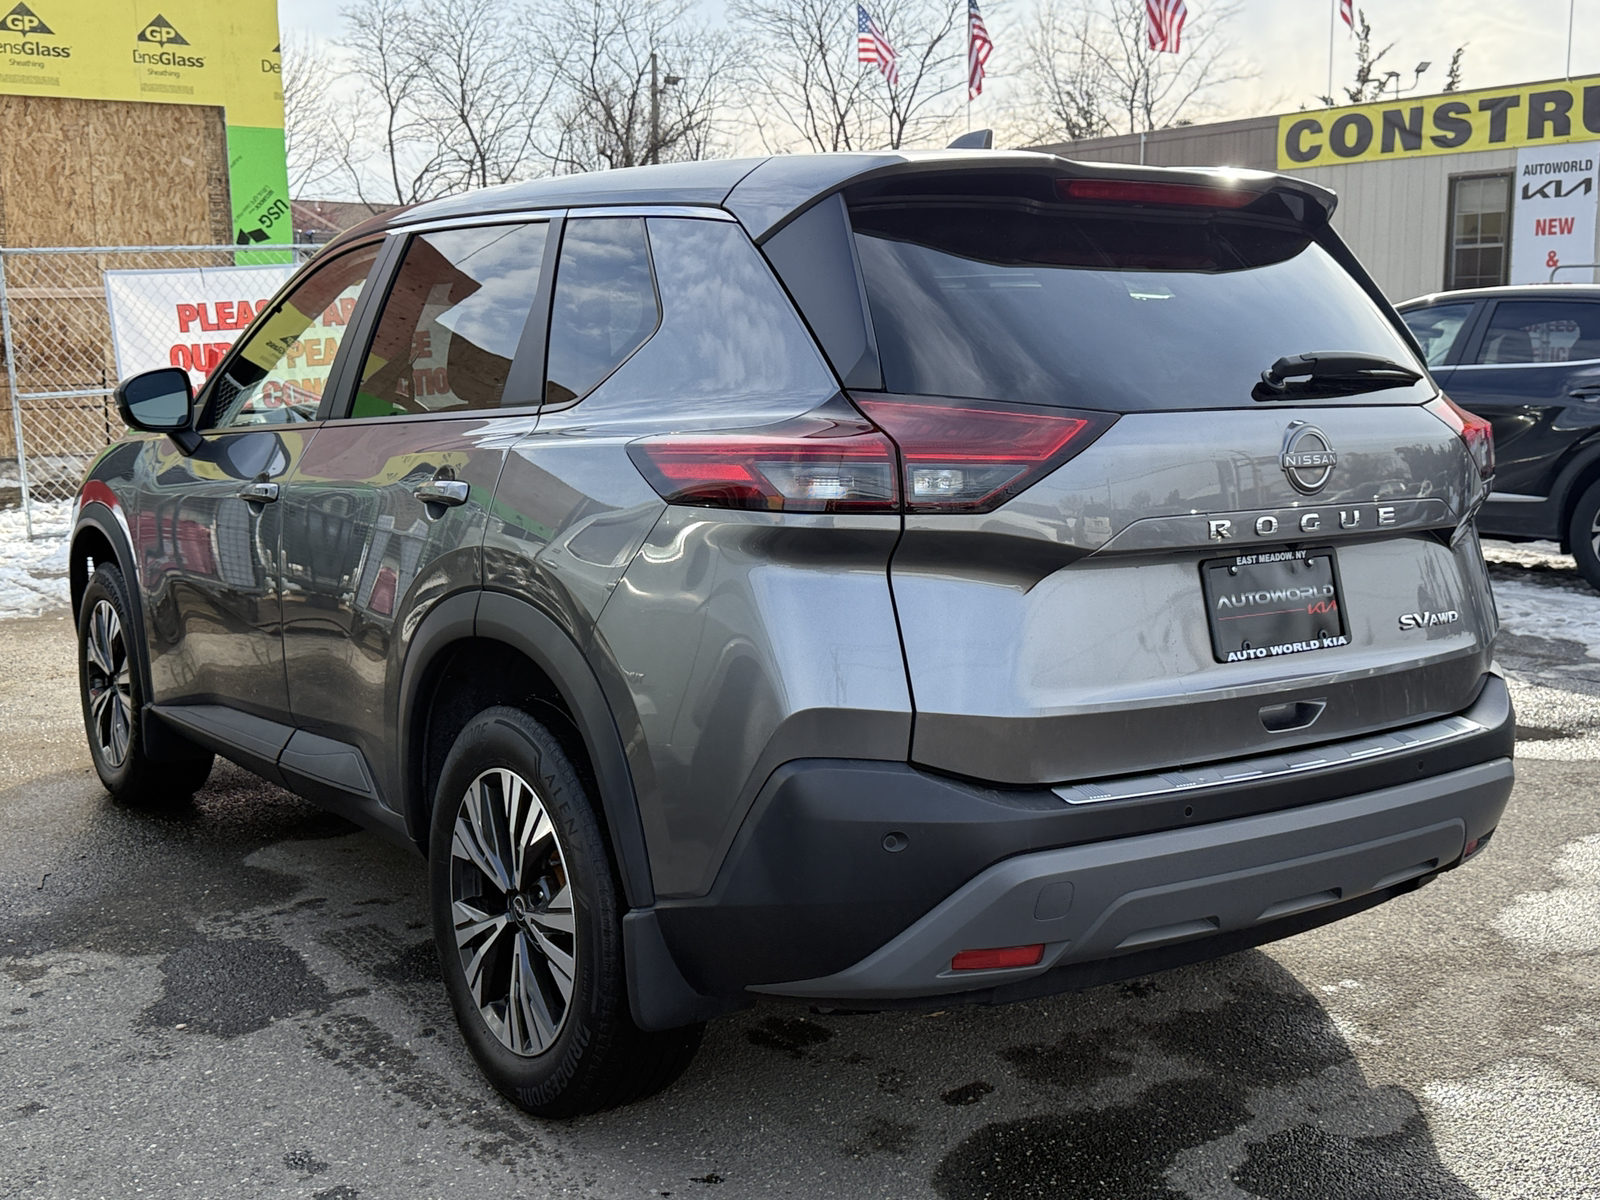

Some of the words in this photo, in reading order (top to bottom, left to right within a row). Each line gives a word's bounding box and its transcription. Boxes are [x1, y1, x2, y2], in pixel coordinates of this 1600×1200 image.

[5, 13, 40, 32] GP
[144, 26, 176, 43] GP
[1523, 159, 1593, 177] AUTOWORLD
[1522, 177, 1593, 201] KIA
[258, 198, 290, 229] USG
[1534, 217, 1575, 237] NEW
[1545, 250, 1560, 268] &
[1284, 452, 1337, 468] NISSAN
[1208, 506, 1396, 540] ROGUE
[1236, 555, 1257, 566] EAST
[1295, 550, 1307, 560] NY
[1217, 584, 1334, 610] AUTOWORLD
[1307, 599, 1338, 615] KIA
[1227, 648, 1267, 662] AUTO
[1270, 640, 1320, 655] WORLD
[1323, 636, 1348, 648] KIA
